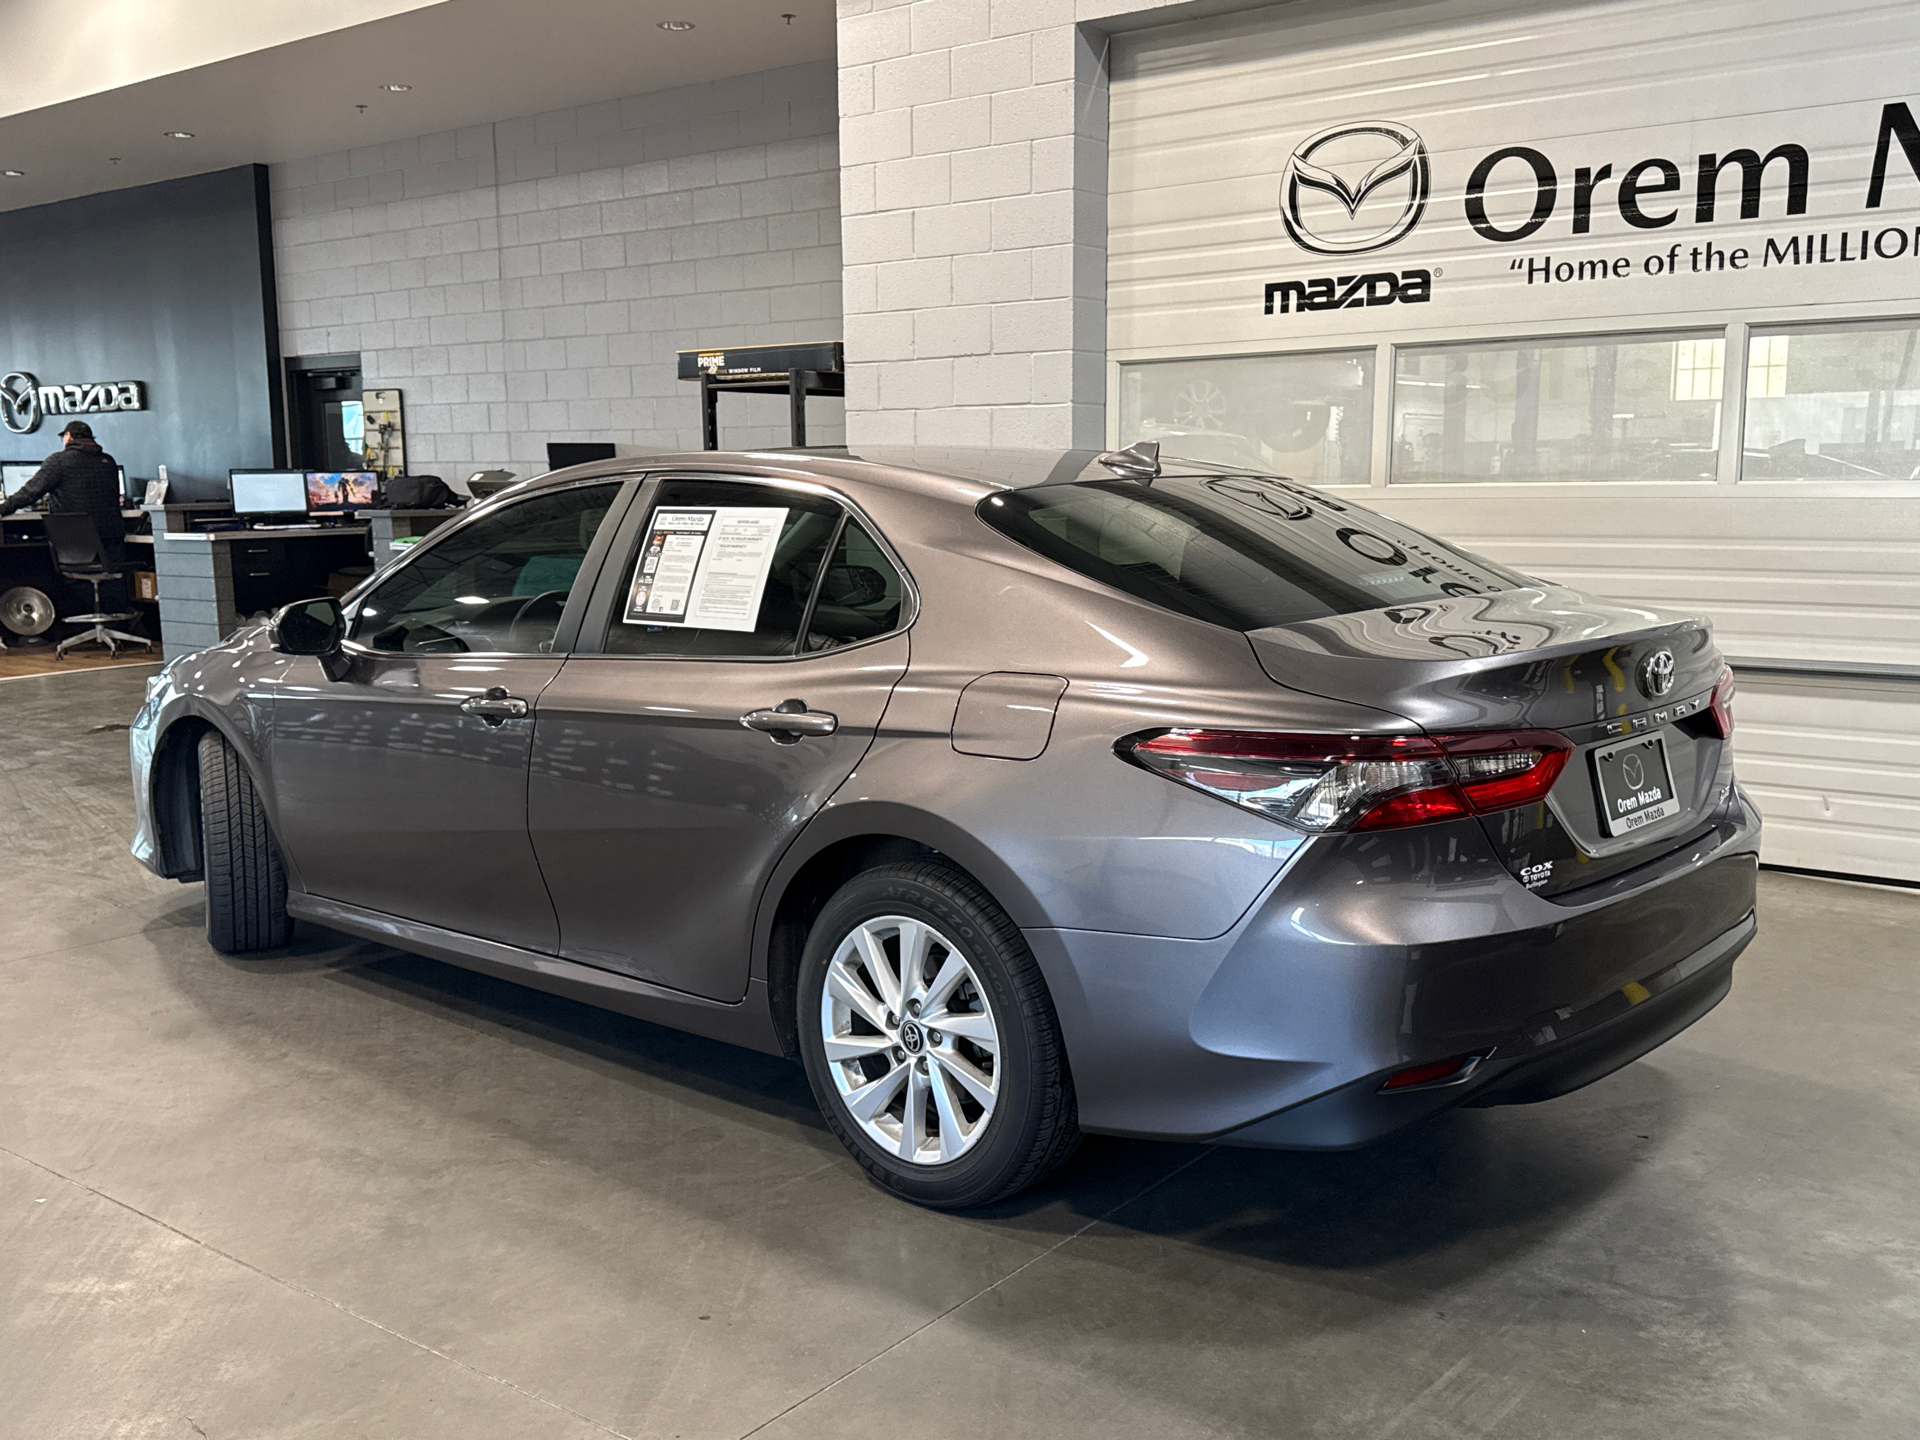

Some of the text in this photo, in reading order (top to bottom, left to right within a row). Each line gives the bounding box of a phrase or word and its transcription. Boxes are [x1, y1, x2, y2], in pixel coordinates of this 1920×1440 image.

[1464, 143, 1810, 242] Orem
[1644, 243, 1682, 276] of
[1690, 241, 1749, 272] the
[697, 355, 725, 368] PRIME
[1607, 699, 1700, 735] CAMRY
[1617, 786, 1662, 813] Orem Mazda
[1626, 807, 1665, 829] Orem Mazda
[1520, 860, 1553, 876] COX
[1530, 870, 1551, 881] TOYOTA
[882, 886, 974, 938] ATREZZO
